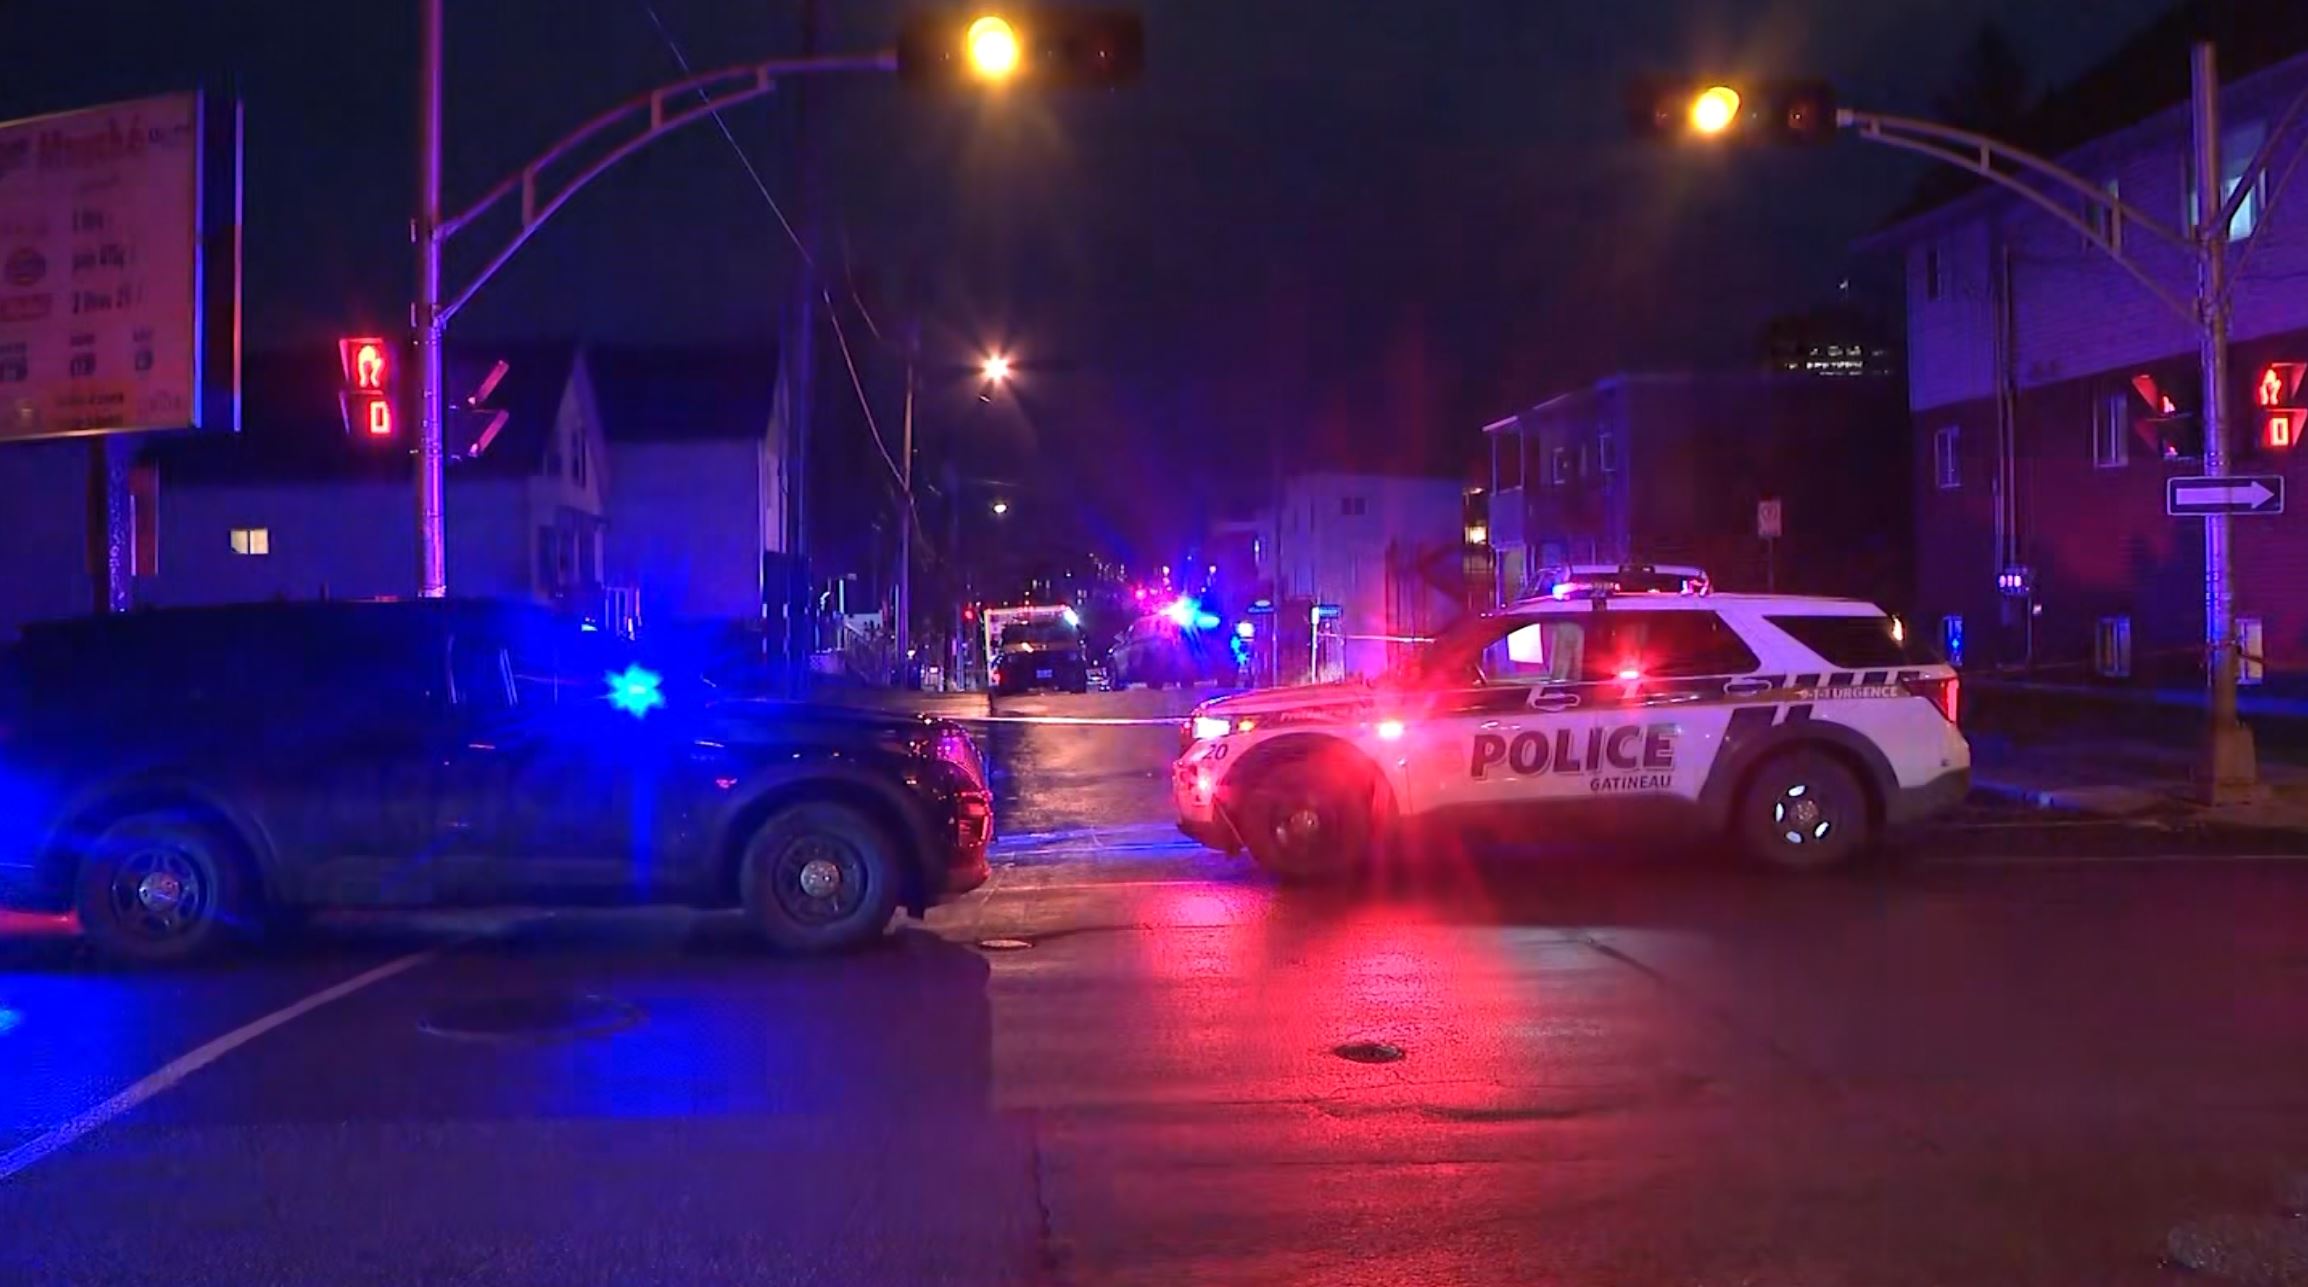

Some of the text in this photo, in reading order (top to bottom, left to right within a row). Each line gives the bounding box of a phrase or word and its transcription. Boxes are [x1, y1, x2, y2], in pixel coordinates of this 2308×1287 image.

[370, 401, 391, 434] 0
[2271, 417, 2289, 446] 0
[1832, 685, 1898, 699] URGENCE
[1203, 744, 1228, 760] 20
[1471, 724, 1677, 778] POLICE
[1590, 775, 1672, 791] GATINEAU
